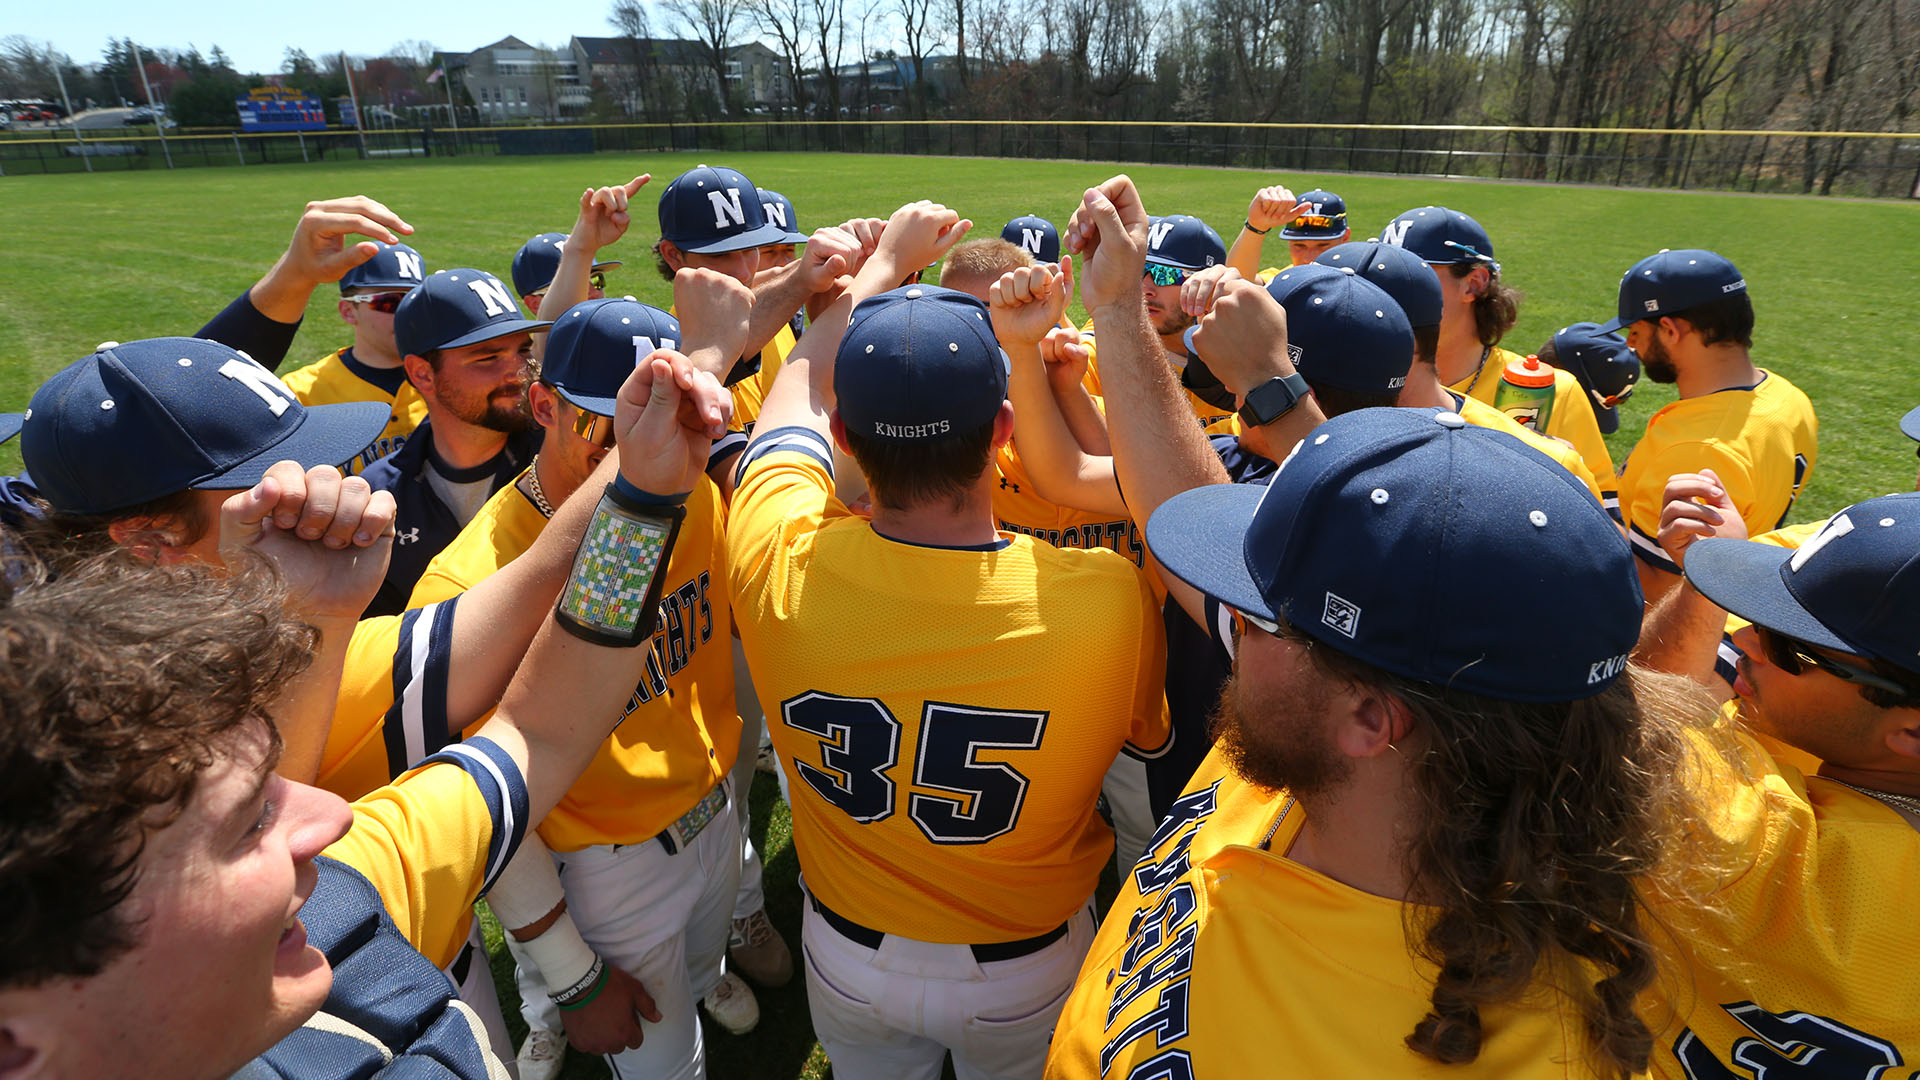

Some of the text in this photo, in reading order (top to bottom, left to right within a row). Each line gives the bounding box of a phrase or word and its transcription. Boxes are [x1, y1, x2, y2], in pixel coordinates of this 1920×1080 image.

[707, 188, 746, 229] N
[763, 202, 788, 228] N
[1022, 229, 1045, 254] N
[1147, 222, 1175, 250] N
[1382, 220, 1414, 248] N
[394, 251, 423, 281] N
[468, 278, 518, 318] N
[217, 349, 297, 418] N
[875, 419, 951, 438] KNIGHTS
[780, 689, 1050, 845] 35
